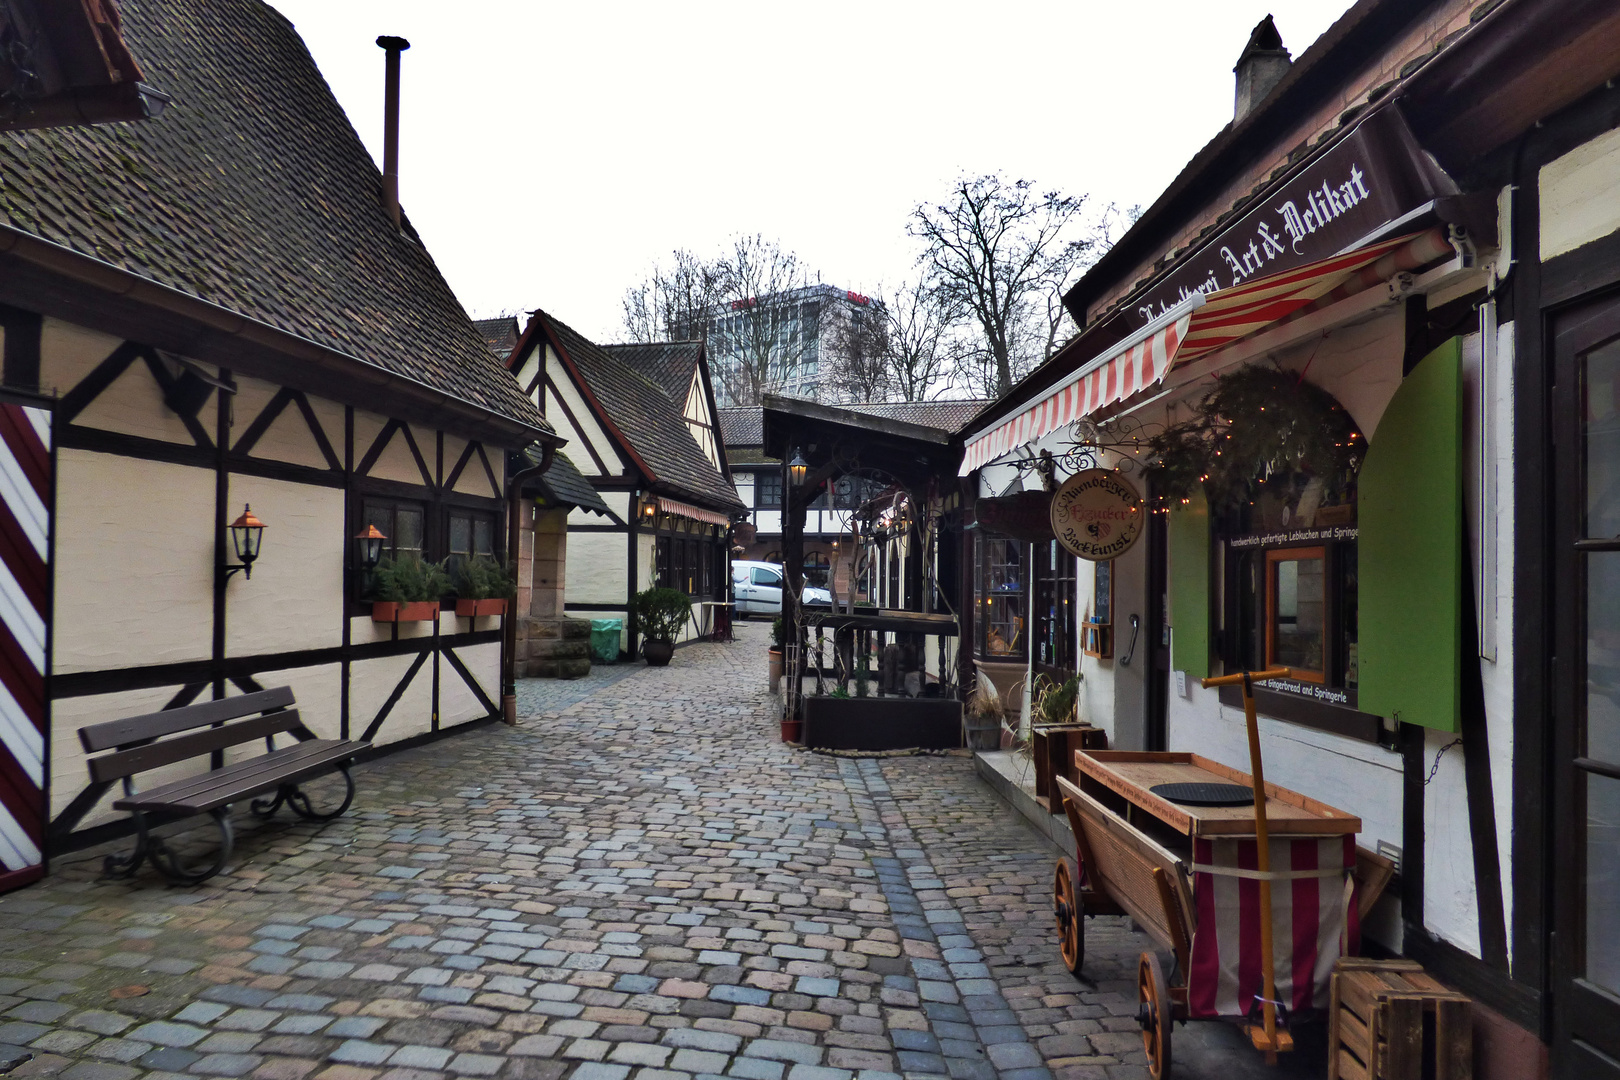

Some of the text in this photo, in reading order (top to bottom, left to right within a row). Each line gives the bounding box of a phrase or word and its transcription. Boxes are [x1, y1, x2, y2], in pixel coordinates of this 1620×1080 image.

[1220, 238, 1264, 287] Art
[1257, 221, 1285, 260] &
[1274, 163, 1370, 256] Delikat
[731, 297, 756, 310] ERO
[847, 291, 870, 306] ERGO
[1062, 527, 1132, 556] Backkunst
[1260, 533, 1288, 547] gefertigte
[1288, 529, 1319, 541] Lebkuchen
[1320, 527, 1332, 539] und
[1268, 679, 1301, 693] Gingerbread
[1302, 685, 1313, 696] and
[1314, 687, 1347, 703] Springerle
